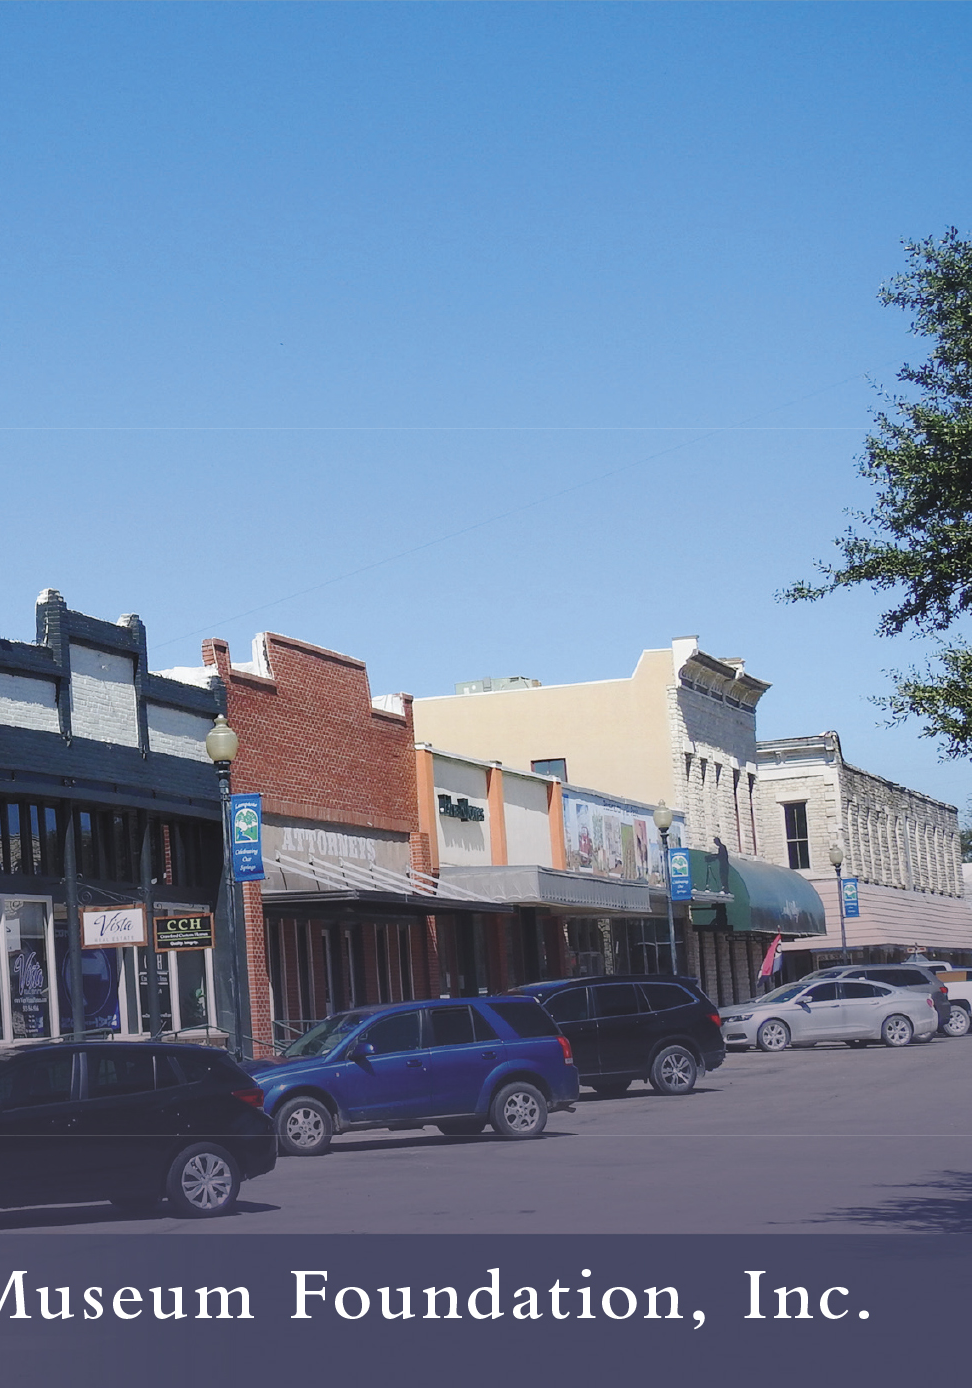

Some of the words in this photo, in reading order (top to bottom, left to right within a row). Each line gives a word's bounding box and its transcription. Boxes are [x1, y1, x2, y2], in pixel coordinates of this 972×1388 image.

[281, 826, 376, 860] ATTORNEYS
[93, 911, 135, 937] Vista
[166, 918, 202, 931] CCH
